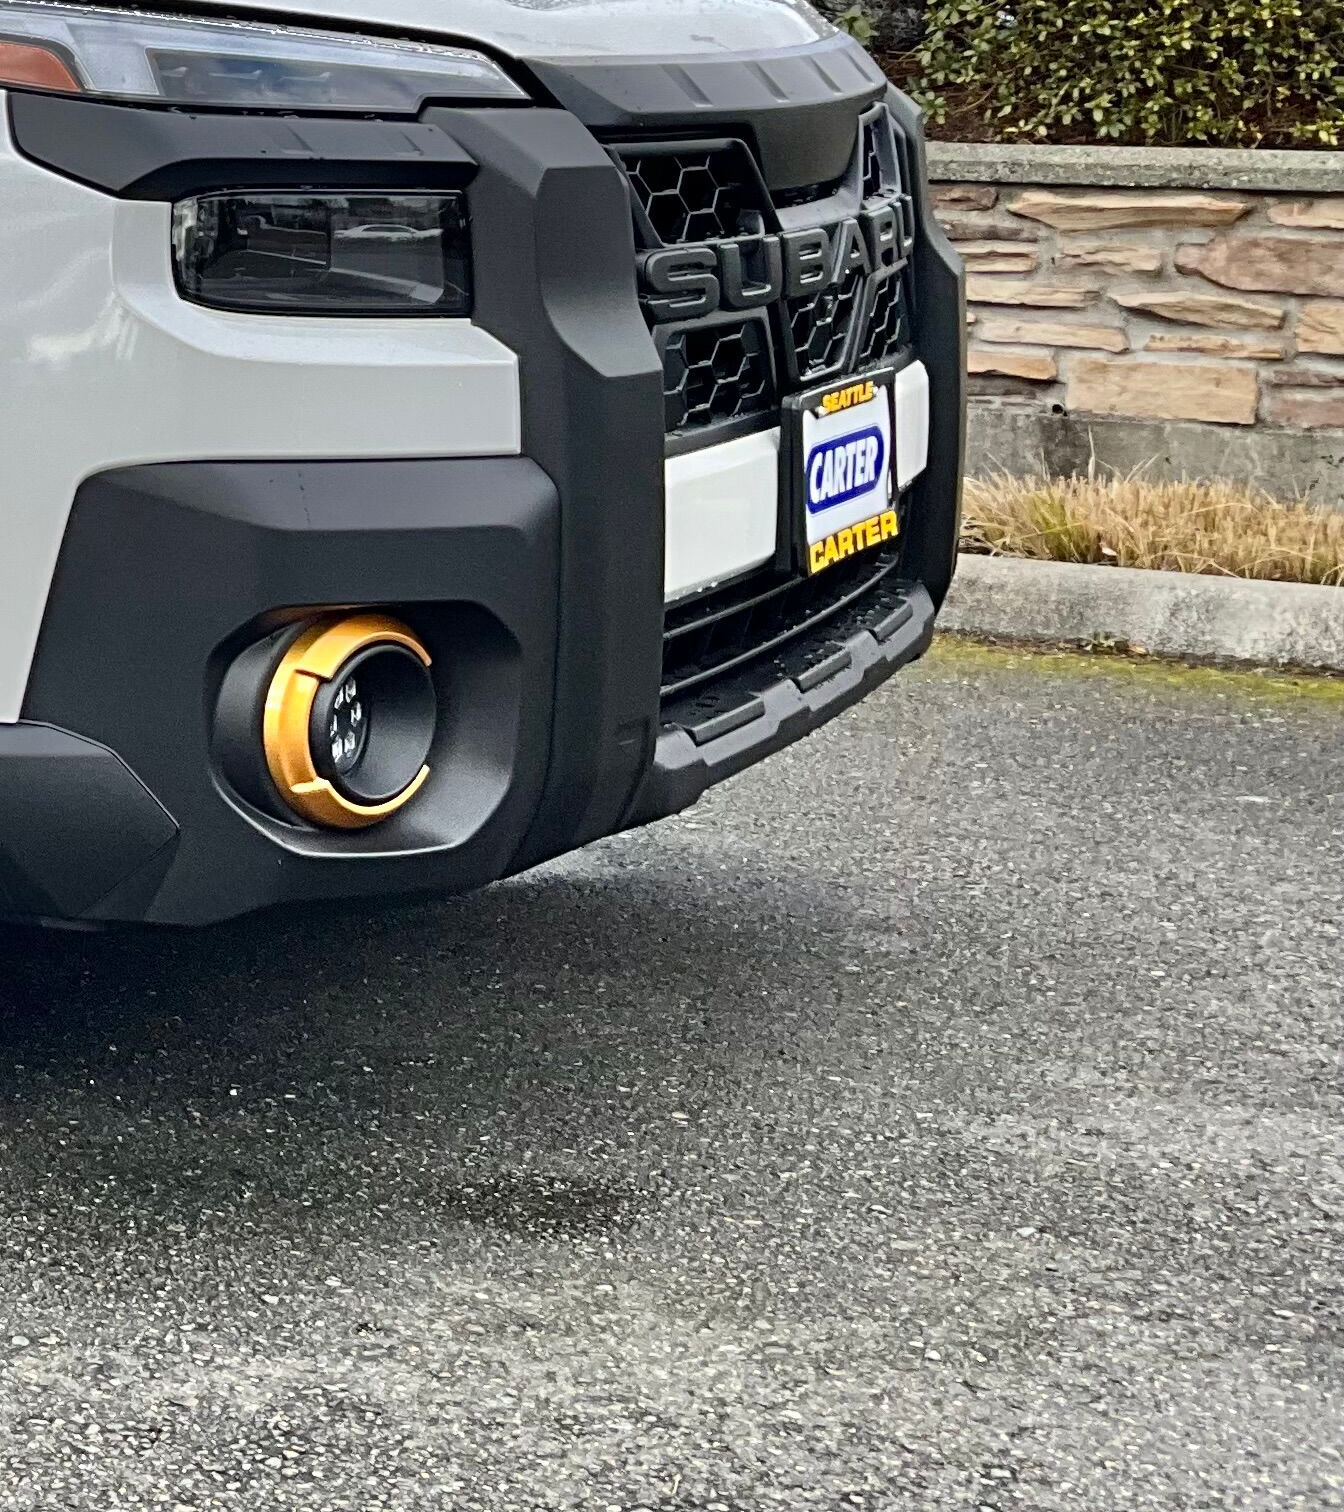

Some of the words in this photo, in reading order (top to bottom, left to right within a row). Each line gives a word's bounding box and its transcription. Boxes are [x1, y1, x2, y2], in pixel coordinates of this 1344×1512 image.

[822, 380, 875, 413] SEATTLE
[810, 435, 879, 505] CARTER
[810, 510, 899, 575] CARTER
